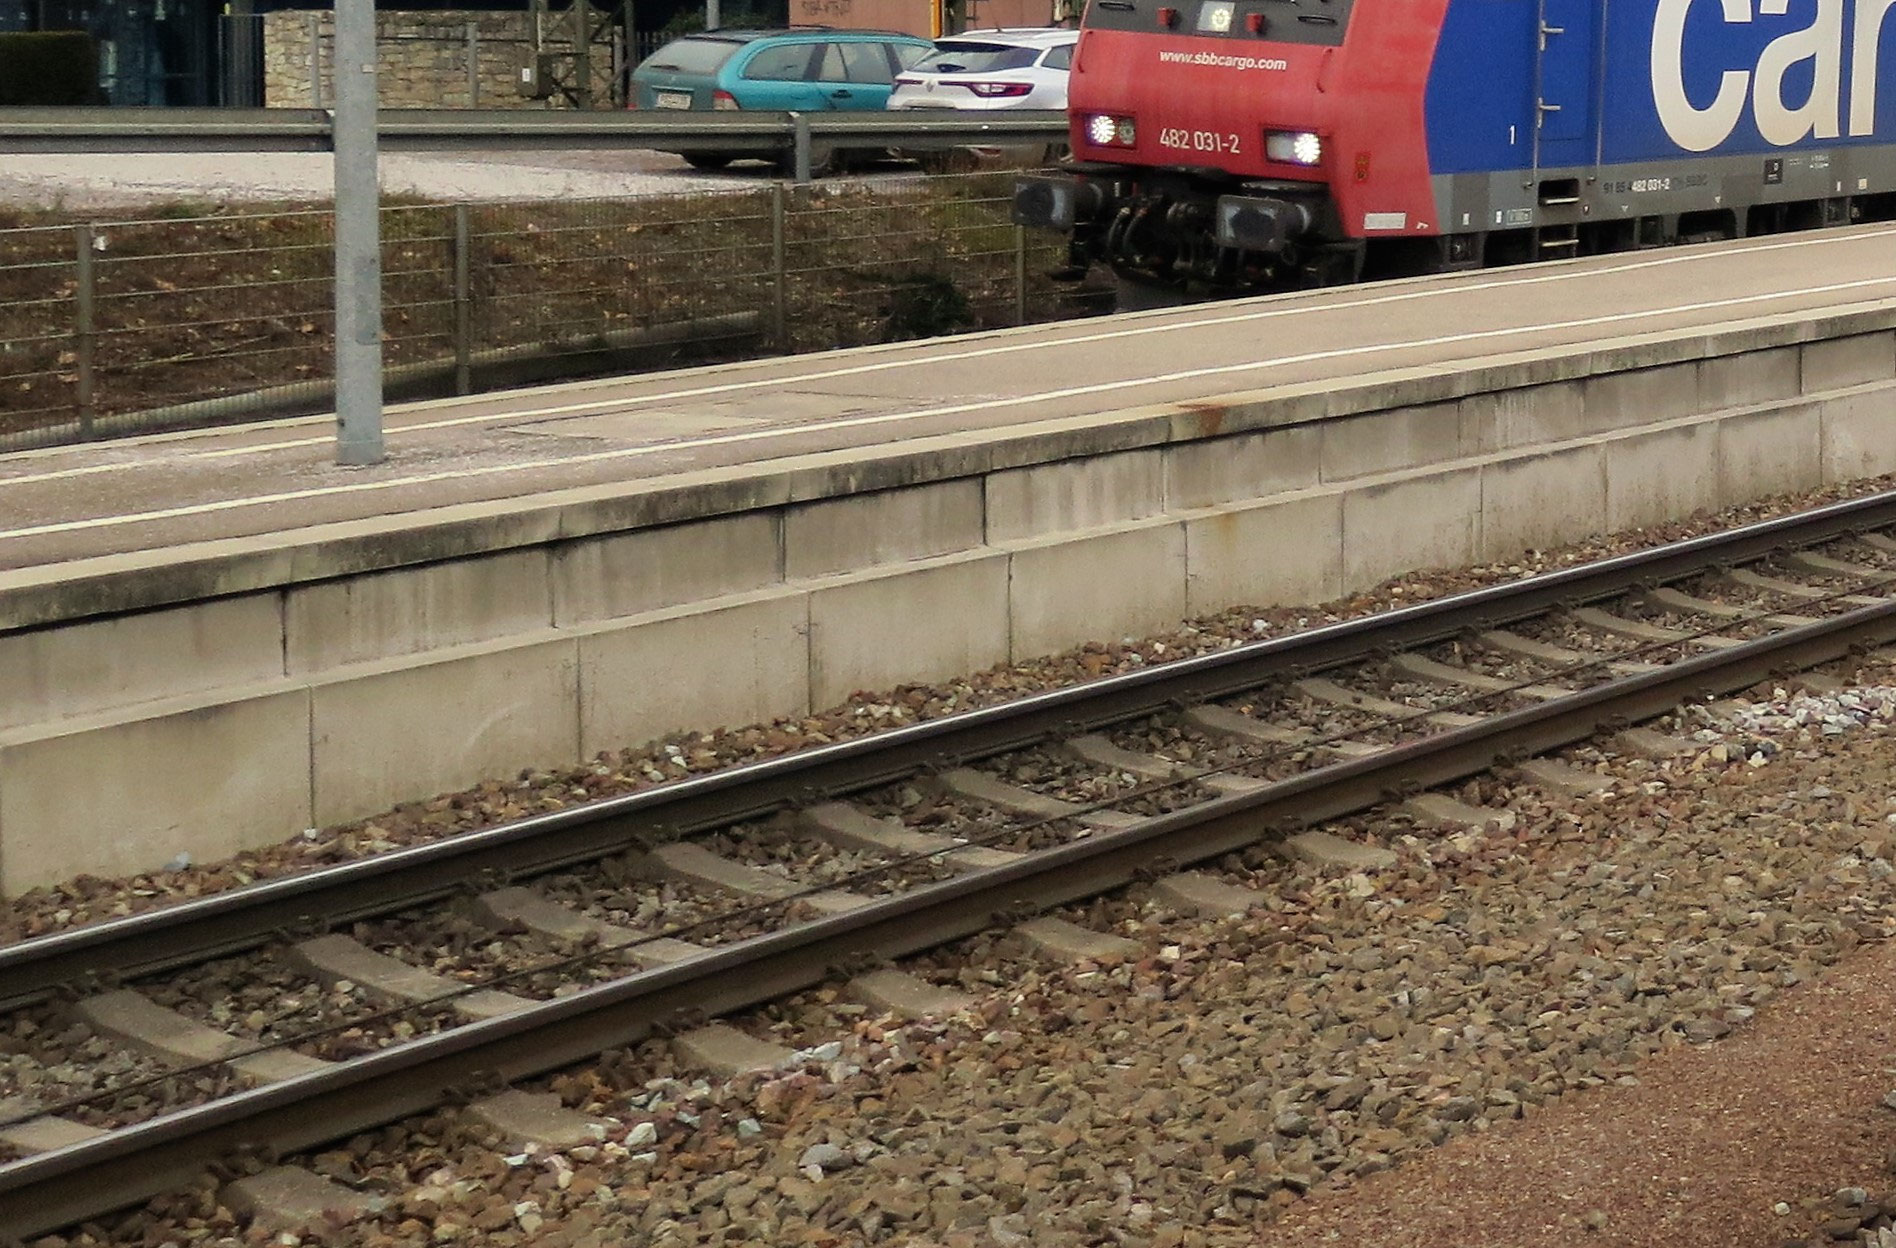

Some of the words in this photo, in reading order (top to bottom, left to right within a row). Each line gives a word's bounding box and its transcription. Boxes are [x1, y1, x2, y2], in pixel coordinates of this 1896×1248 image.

[1159, 51, 1288, 71] www.sbbcargo.com
[1159, 127, 1191, 150] 482
[1193, 131, 1241, 154] 031-2
[1509, 125, 1517, 145] 1
